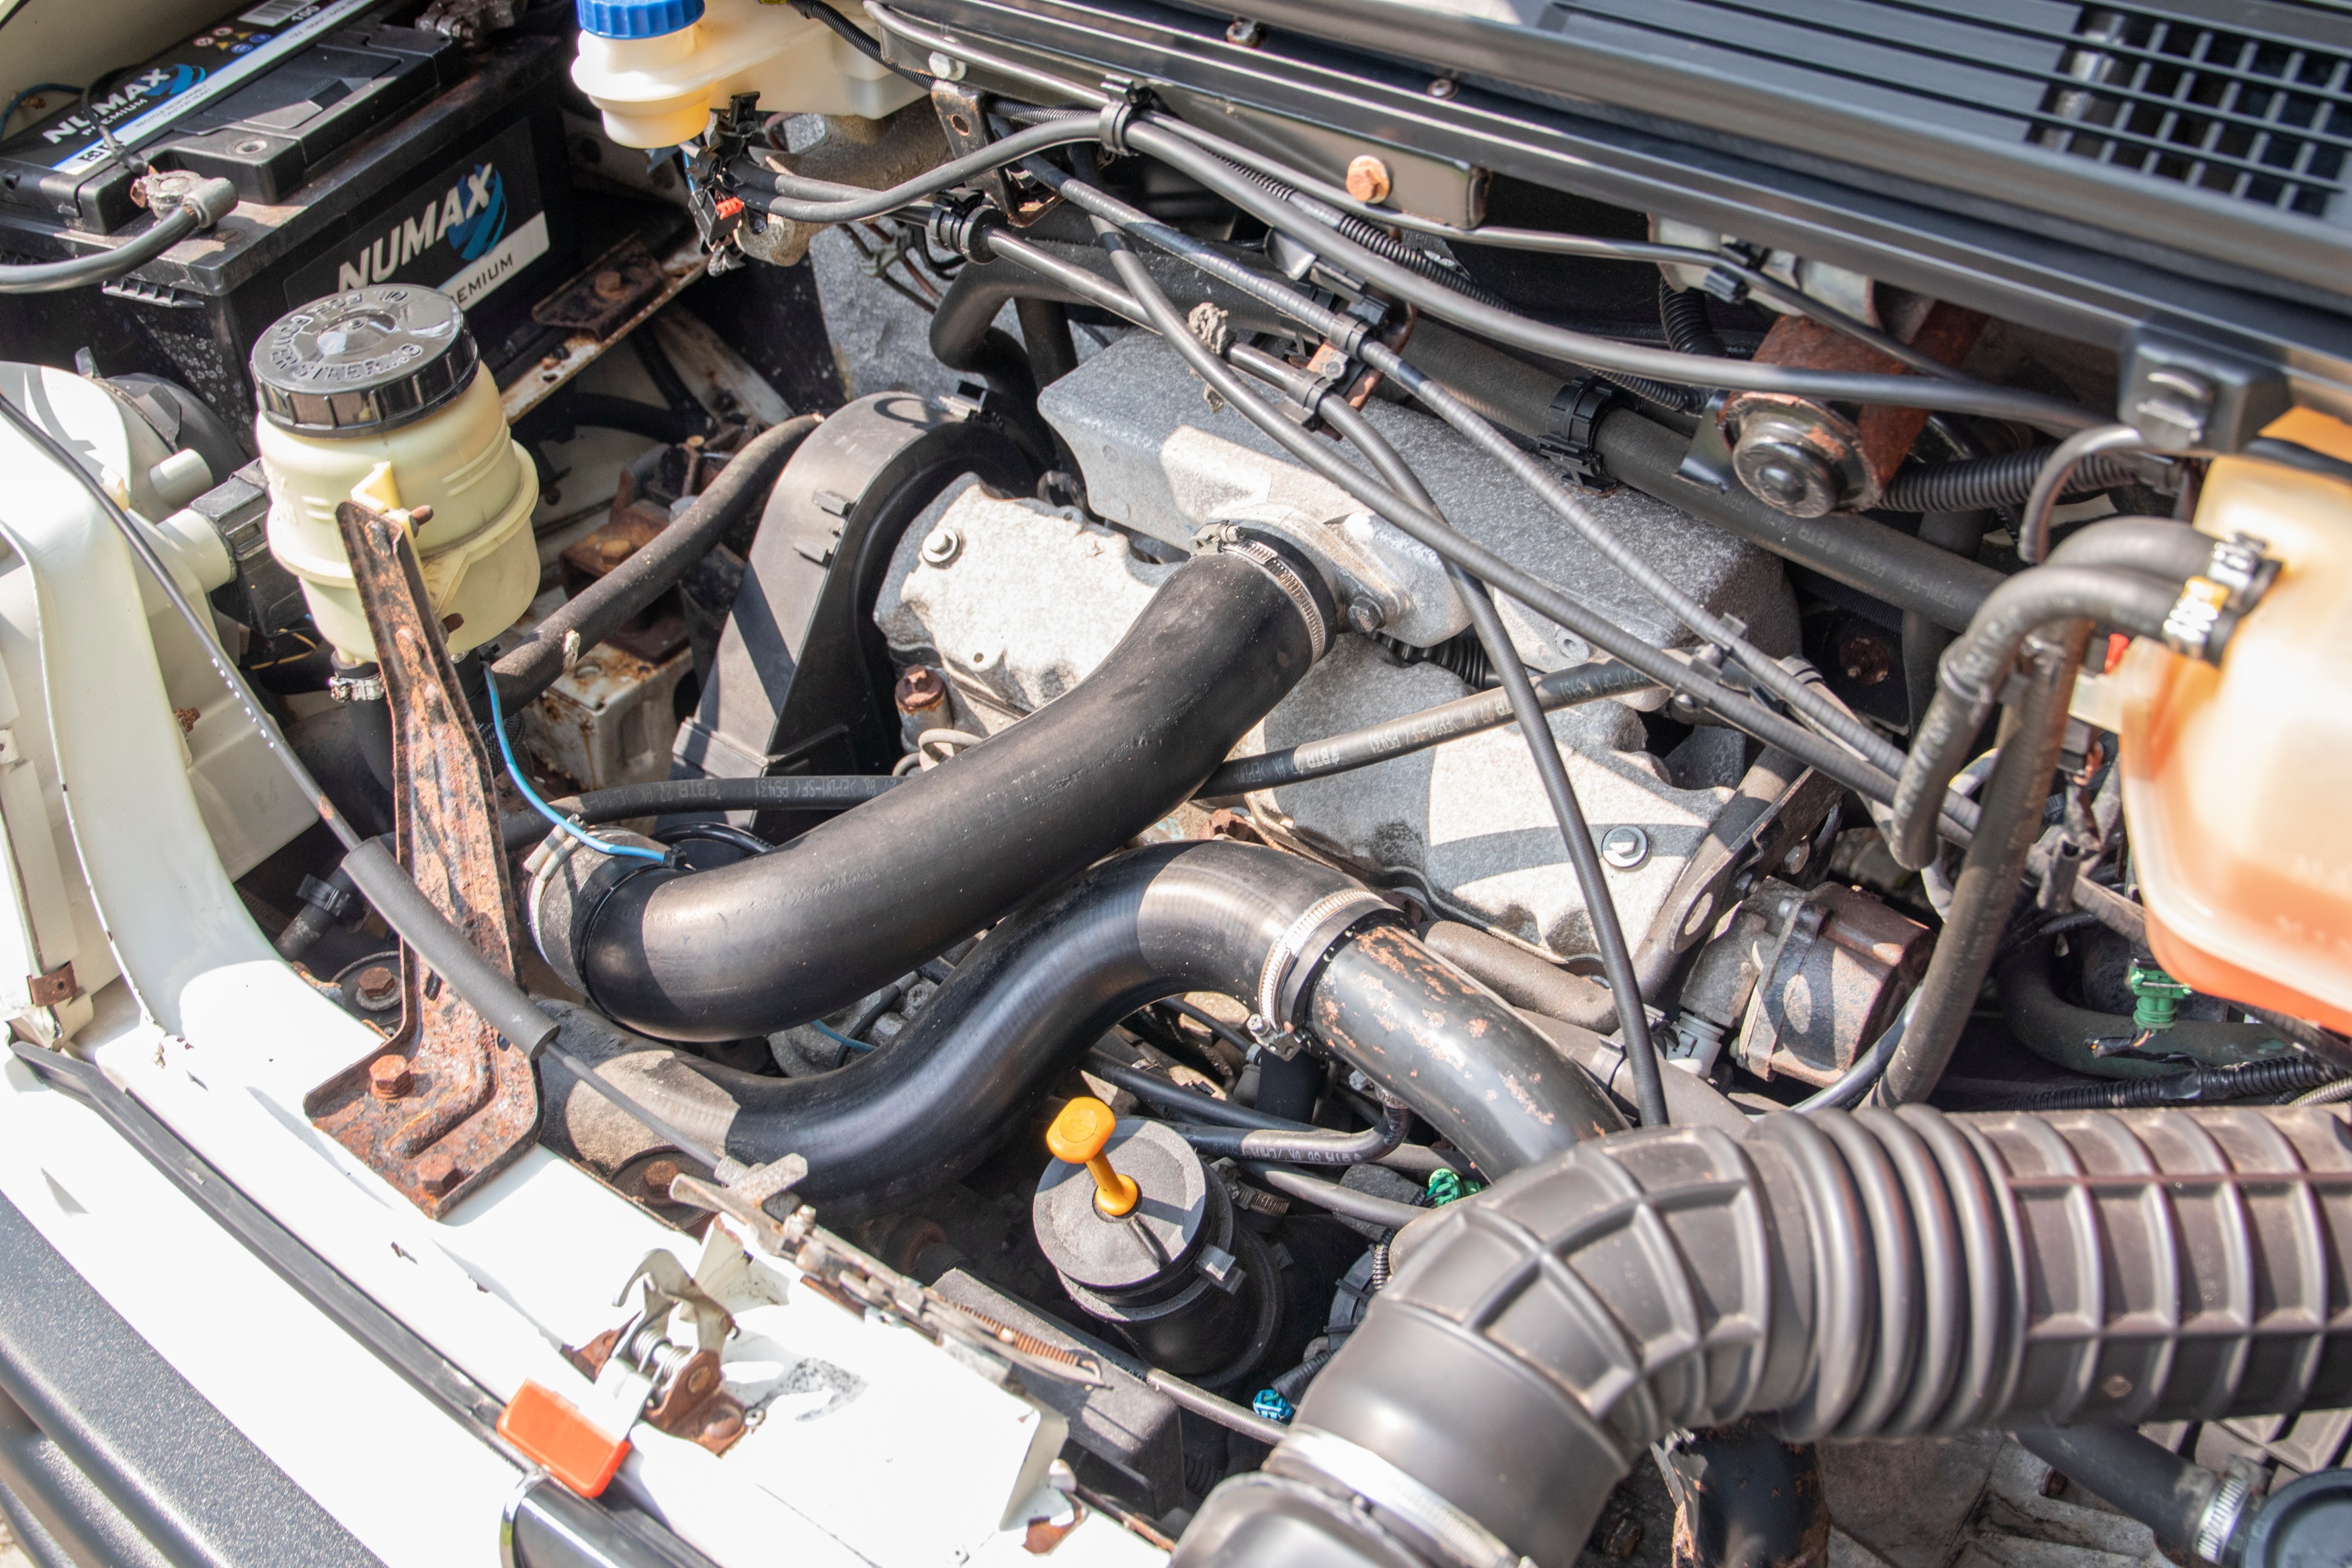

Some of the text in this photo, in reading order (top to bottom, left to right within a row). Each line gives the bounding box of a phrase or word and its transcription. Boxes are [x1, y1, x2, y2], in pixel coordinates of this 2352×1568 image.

[291, 5, 320, 21] 100
[42, 68, 169, 144] NUMAX
[338, 163, 492, 293] NUMAX
[450, 253, 513, 304] EMIUM
[270, 314, 314, 369] POWER
[292, 343, 423, 381] STEERING
[1495, 696, 1513, 717] TR
